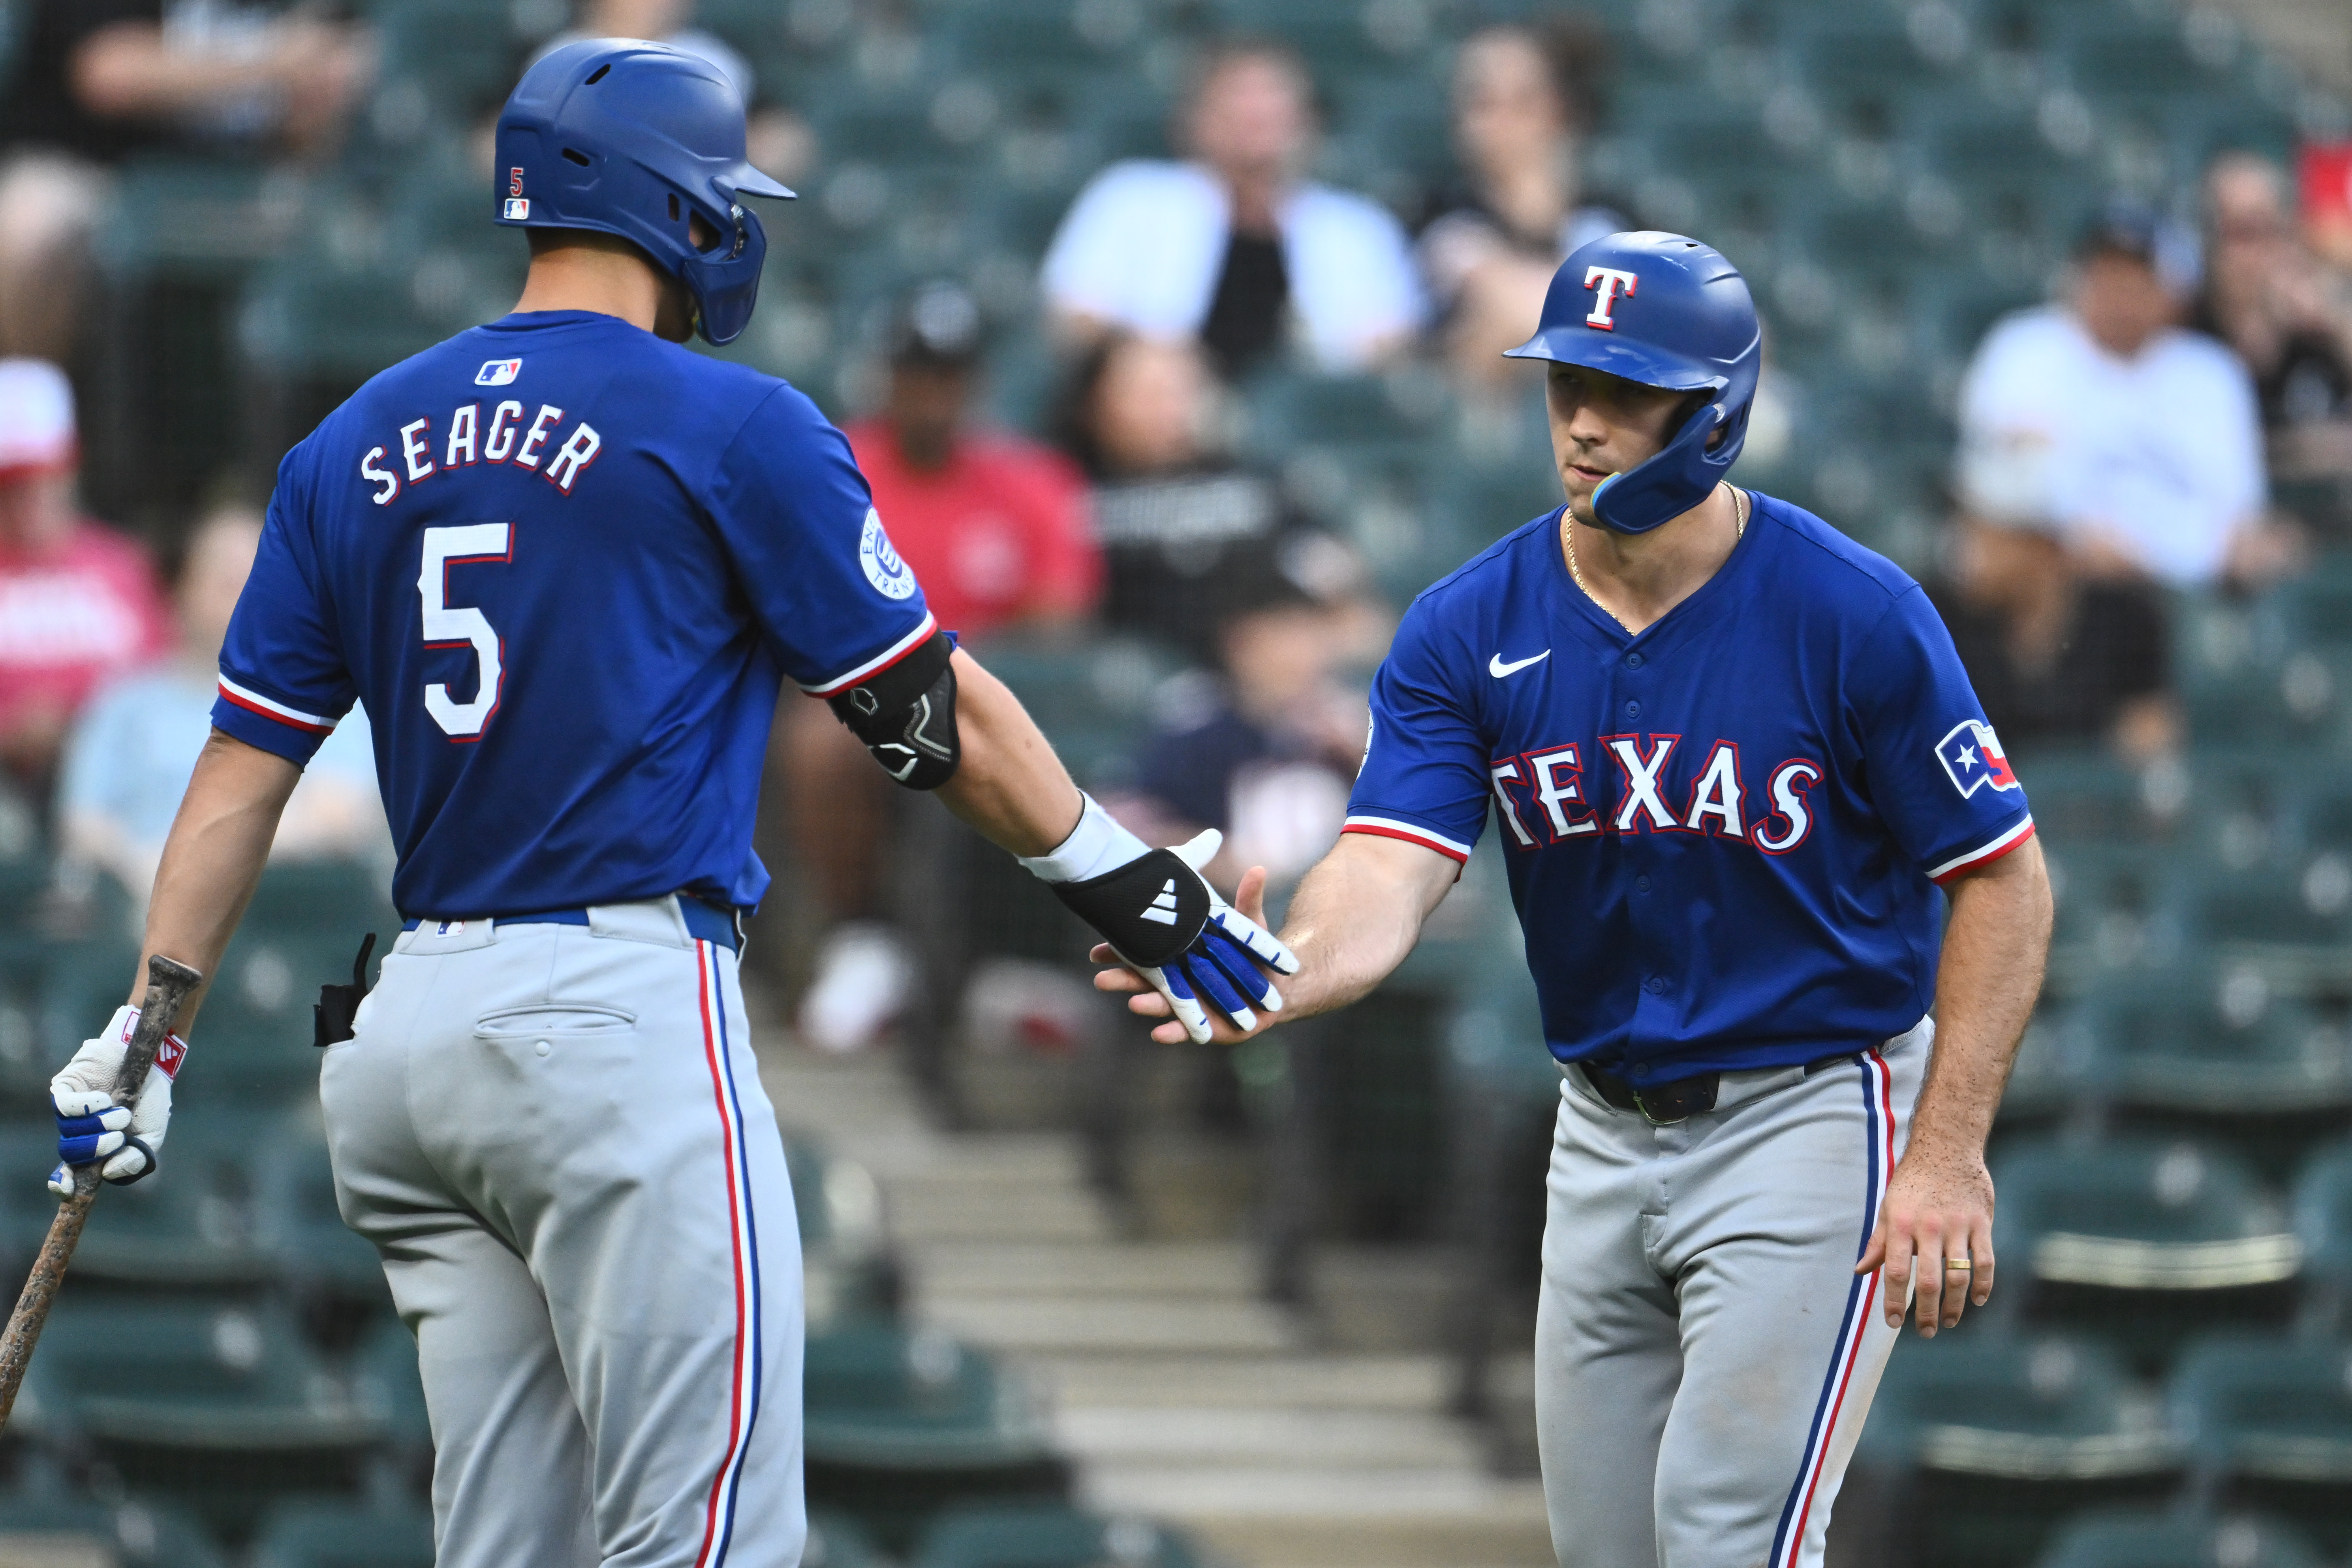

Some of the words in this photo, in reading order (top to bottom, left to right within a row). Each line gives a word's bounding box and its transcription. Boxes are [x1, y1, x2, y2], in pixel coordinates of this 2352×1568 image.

[510, 167, 523, 197] 5
[1584, 266, 1638, 331] T
[361, 400, 601, 507] SEAGER
[874, 568, 912, 595] TRANS
[417, 522, 515, 743] 5
[1489, 733, 1824, 855] TEXAS
